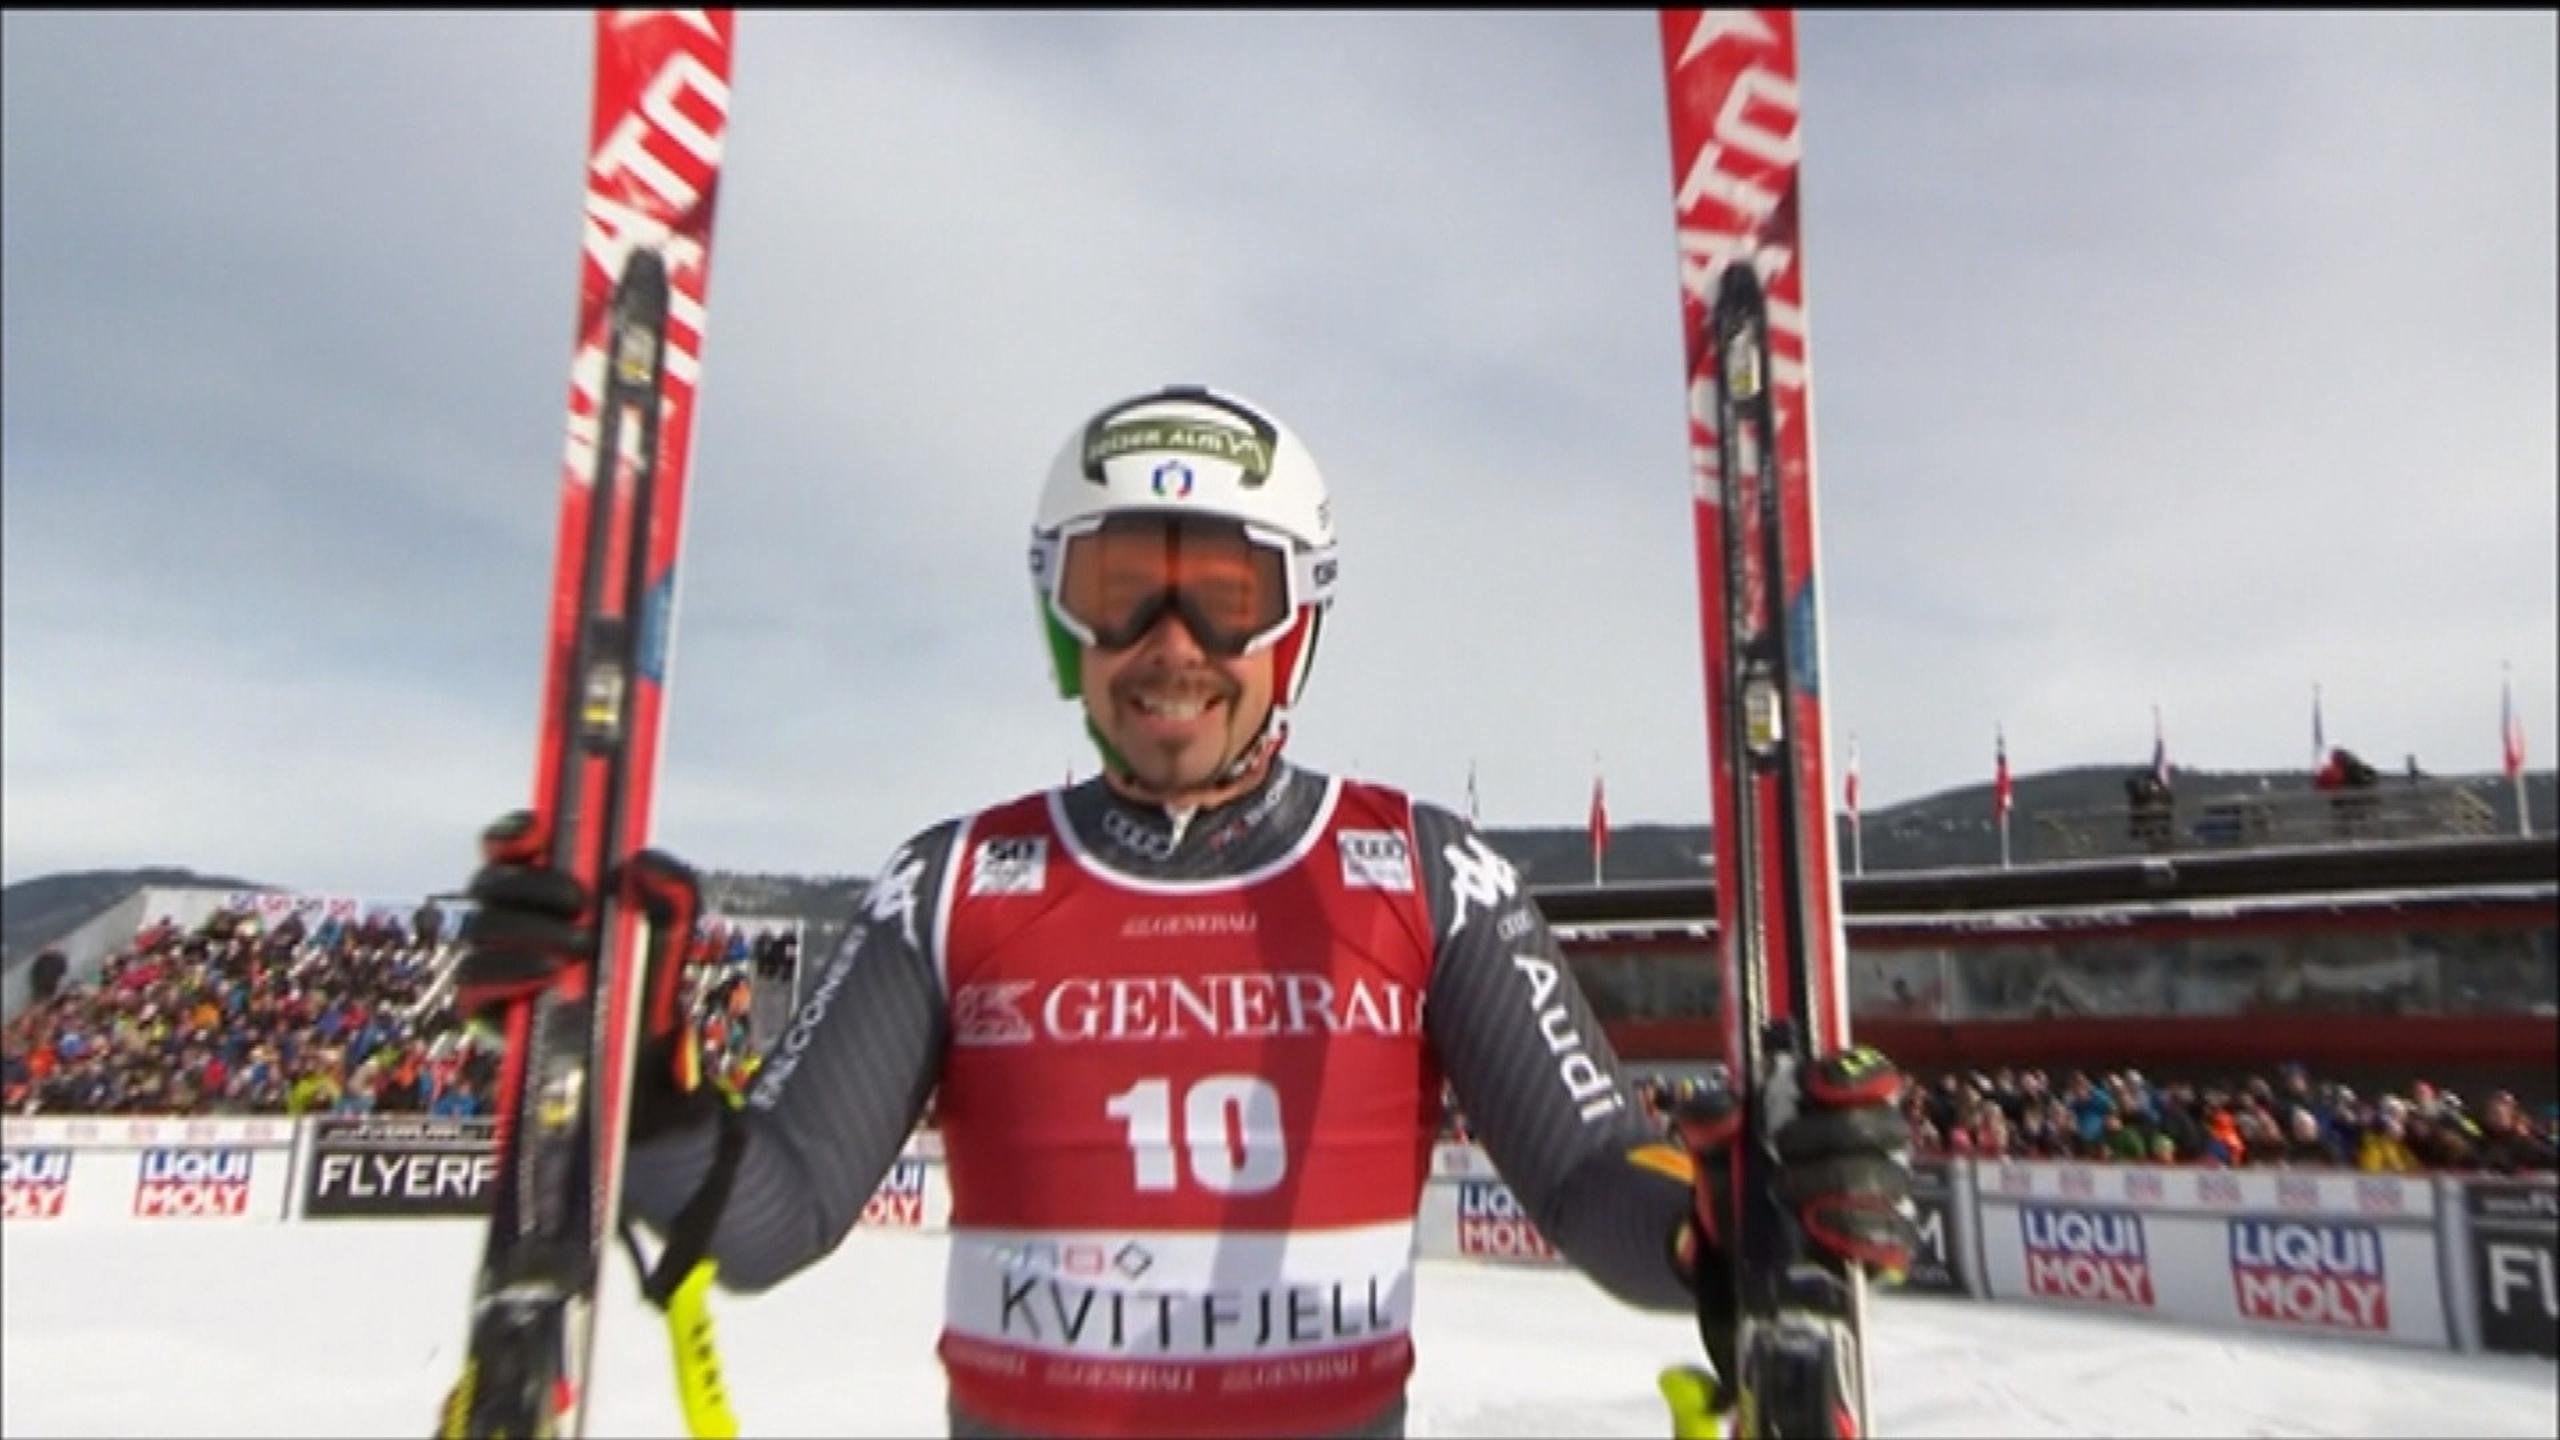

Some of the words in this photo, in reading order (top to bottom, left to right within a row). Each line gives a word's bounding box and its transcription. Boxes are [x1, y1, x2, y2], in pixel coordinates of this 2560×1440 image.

[1513, 953, 1625, 1127] Audi
[1105, 1075, 1288, 1194] 10
[2024, 1210, 2142, 1256] LIQUI
[2235, 1223, 2377, 1274] LIQUI
[2032, 1253, 2147, 1302] MOLY
[2241, 1270, 2383, 1328] MOLY
[1002, 1274, 1392, 1350] KVITFJELL
